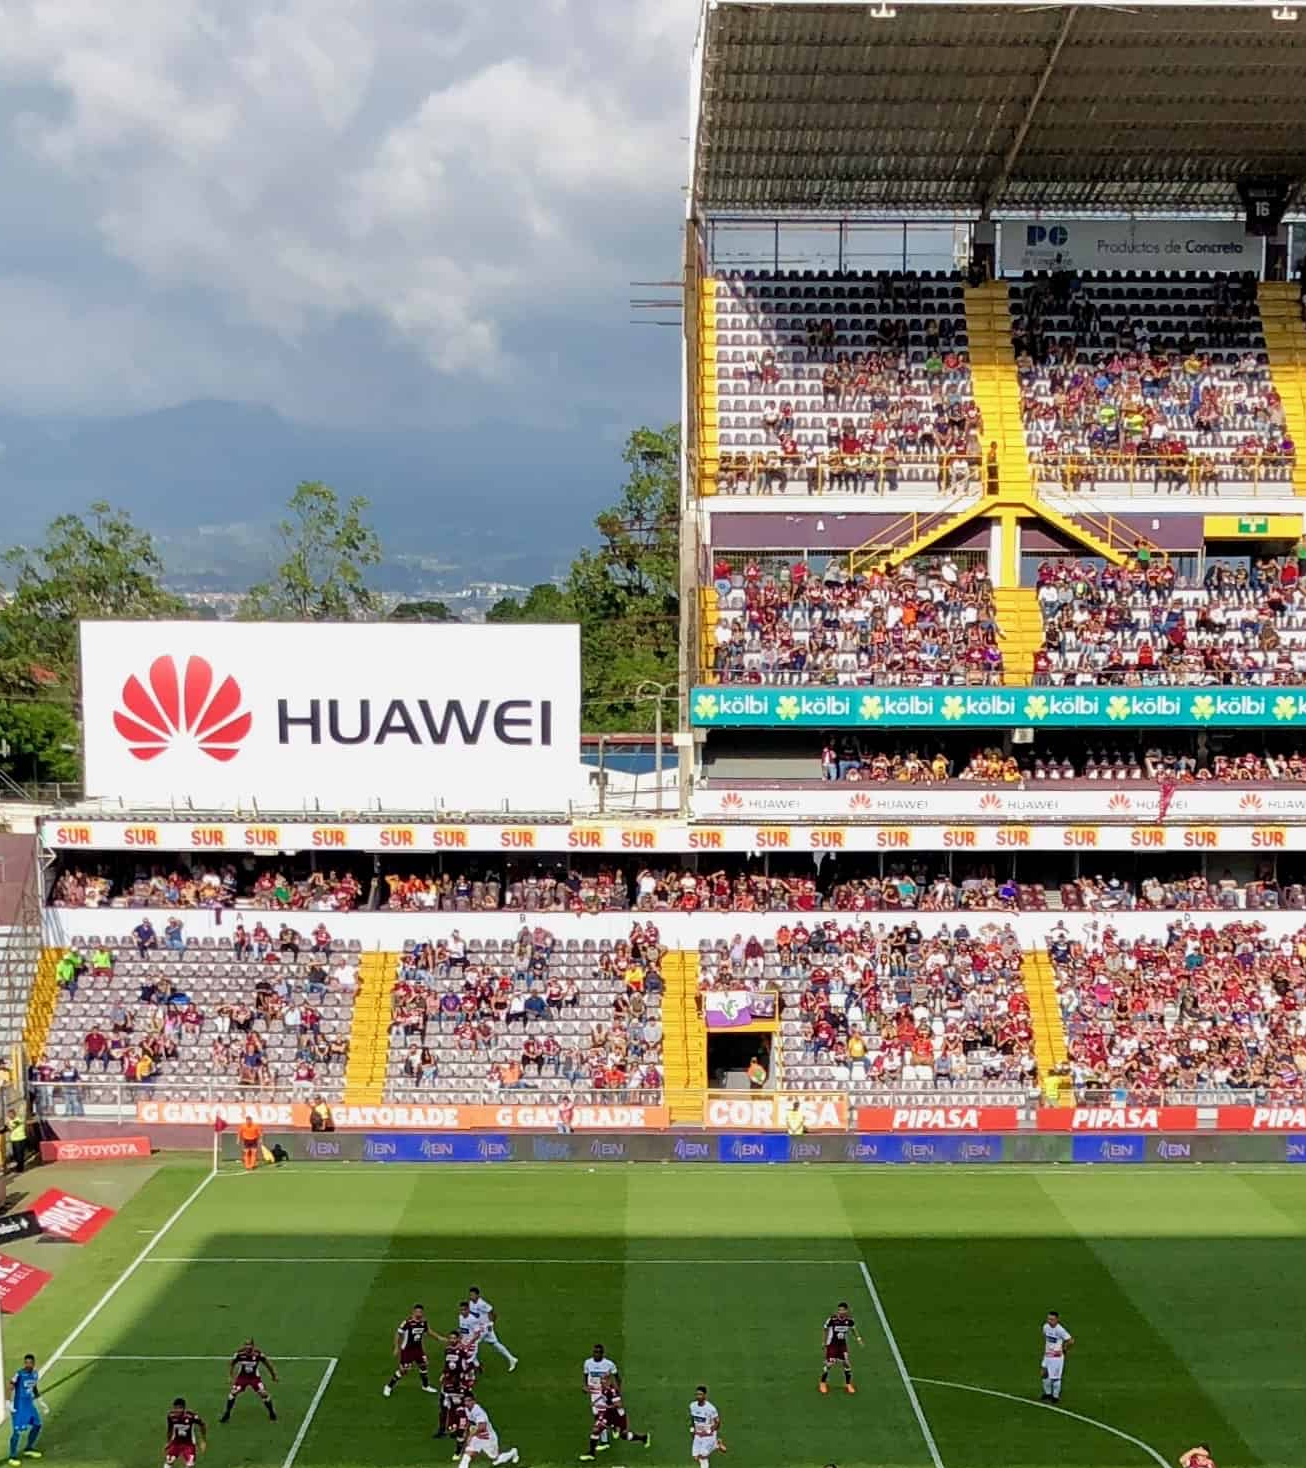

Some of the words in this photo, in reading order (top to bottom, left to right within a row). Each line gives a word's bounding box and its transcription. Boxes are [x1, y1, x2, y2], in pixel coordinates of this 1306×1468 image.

[1255, 201, 1270, 217] 16
[1164, 240, 1182, 254] de
[1185, 240, 1243, 255] Concreto
[816, 519, 825, 531] A
[719, 694, 768, 716] kölbi
[800, 694, 849, 716] kölbi
[884, 694, 933, 716] kölbi
[965, 694, 1014, 716] kölbi
[1050, 695, 1099, 717] kölbi
[1132, 695, 1181, 717] kölbi
[1215, 695, 1264, 717] kölbi
[278, 698, 552, 746] HUAWEI
[57, 828, 90, 844] SUR
[124, 829, 157, 845] SUR
[191, 829, 225, 845] SUR
[245, 829, 278, 845] SUR
[312, 830, 346, 846] SUR
[379, 830, 413, 846] SUR
[433, 830, 467, 846] SUR
[500, 831, 534, 847] SUR
[568, 831, 601, 847] SUR
[622, 831, 655, 847] SUR
[688, 832, 722, 848] SUR
[756, 832, 789, 848] SUR
[810, 832, 843, 848] SUR
[877, 832, 910, 848] SUR
[943, 832, 976, 848] SUR
[997, 831, 1030, 847] SUR
[1063, 831, 1096, 847] SUR
[1131, 831, 1164, 847] SUR
[1184, 831, 1217, 847] SUR
[1251, 831, 1285, 847] SUR
[144, 1103, 159, 1122] G
[164, 1103, 292, 1123] GATORADE
[332, 1104, 459, 1125] GATORADE
[496, 1106, 513, 1126] G
[893, 1108, 978, 1128] PIPASA
[1072, 1108, 1158, 1128] PIPASA
[82, 1143, 138, 1156] TOYOTA
